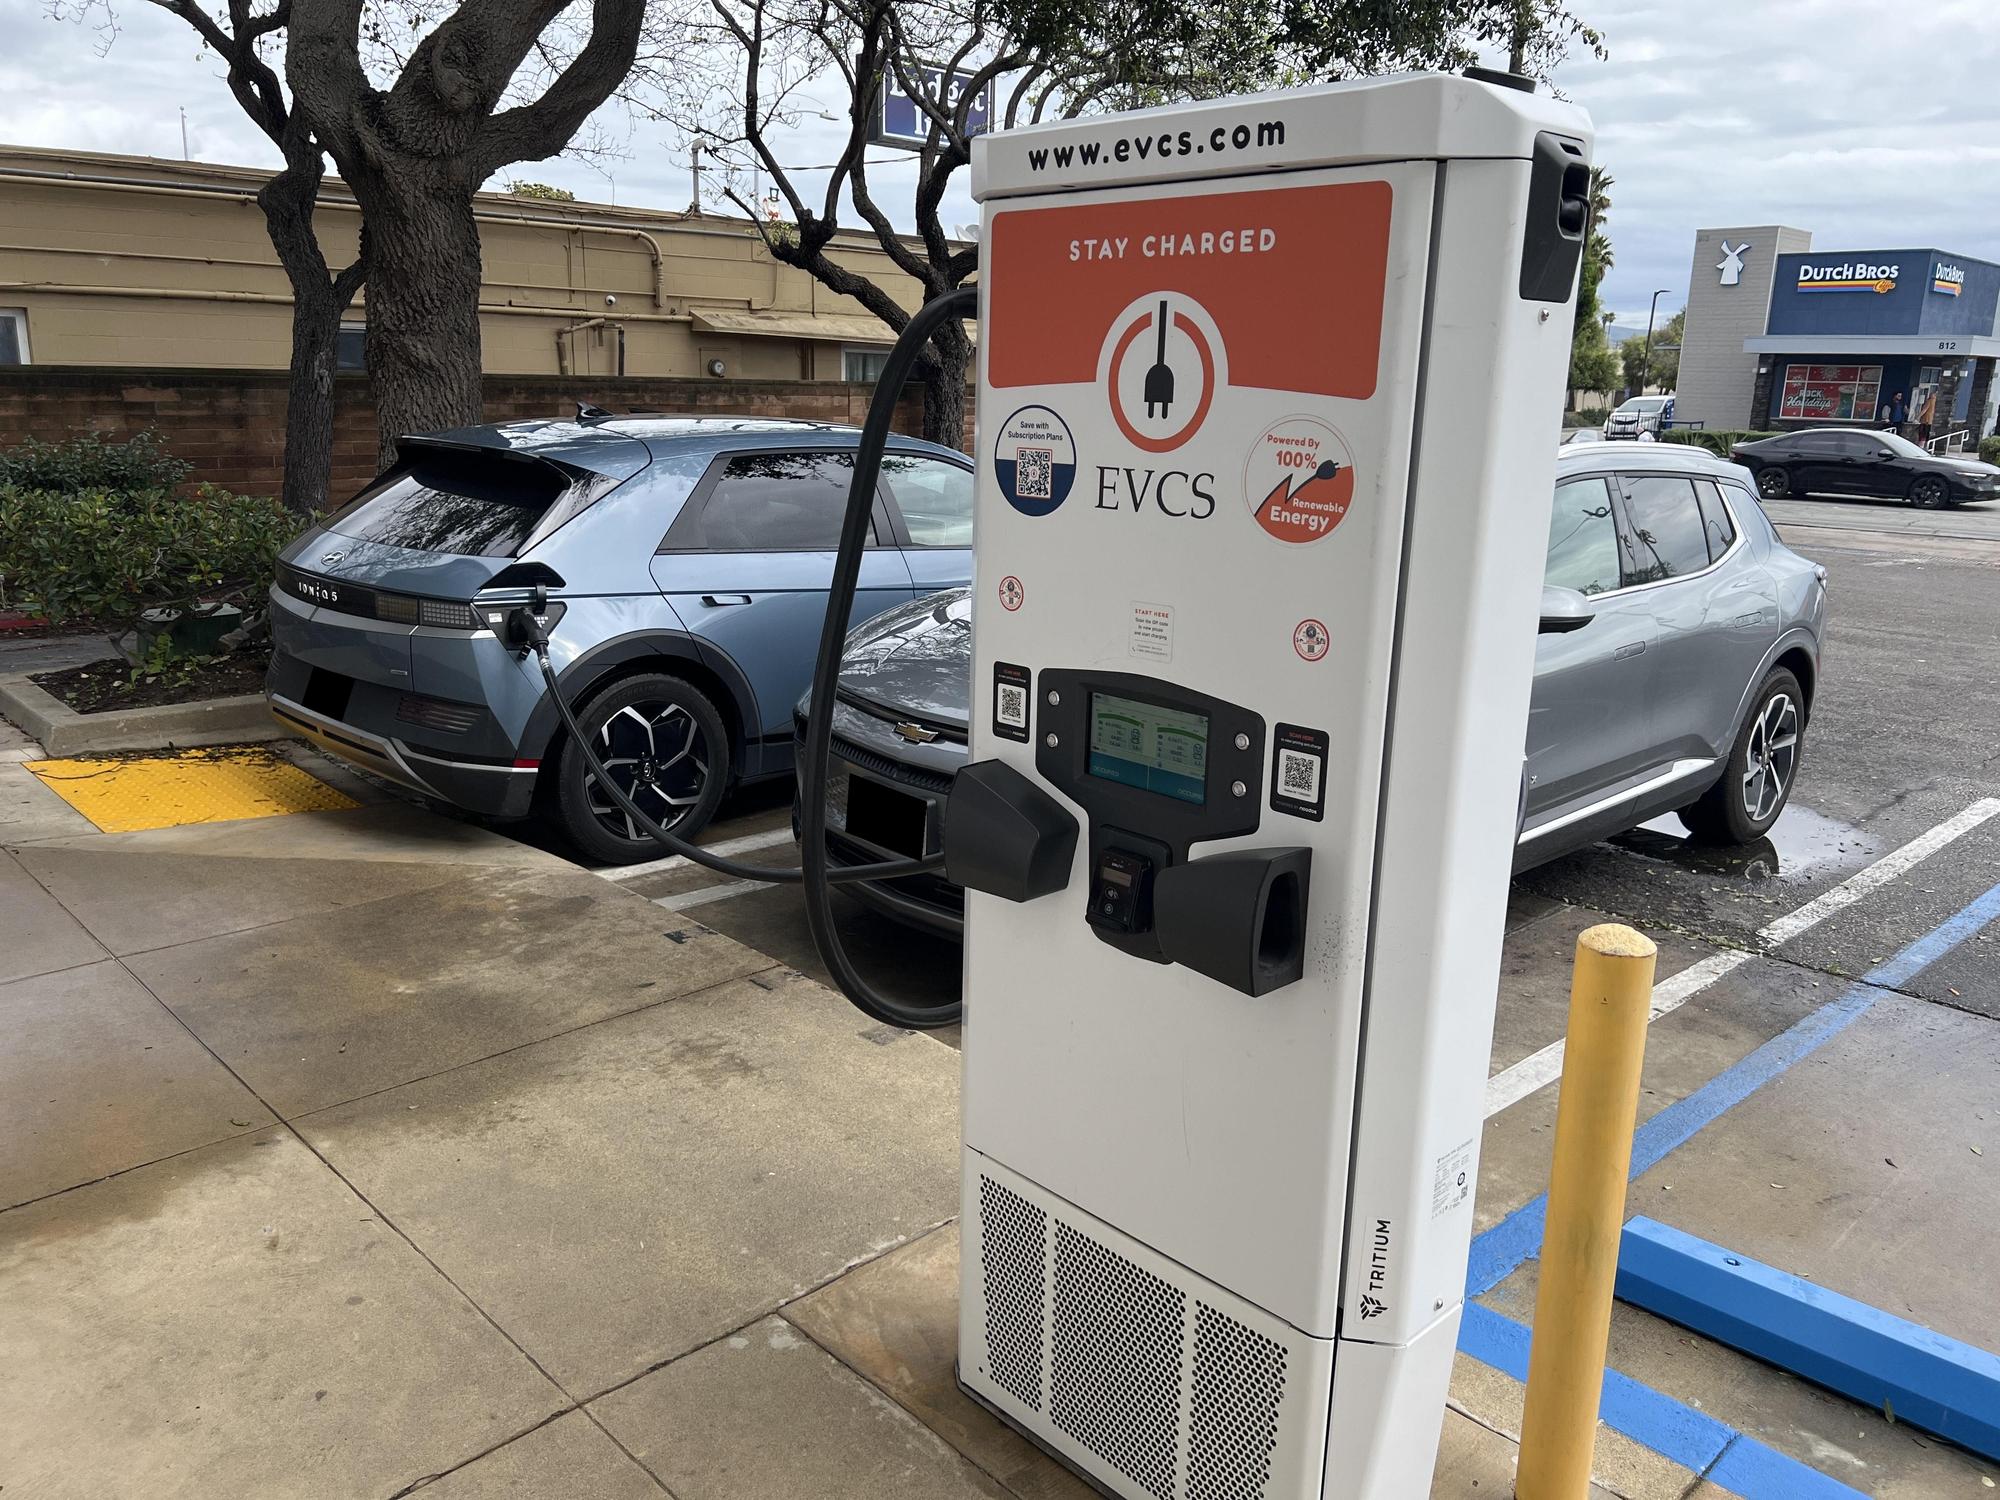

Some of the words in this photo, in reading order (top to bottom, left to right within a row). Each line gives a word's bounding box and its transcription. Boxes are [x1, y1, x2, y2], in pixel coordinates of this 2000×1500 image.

[889, 64, 985, 112] Bdgt
[1028, 120, 1285, 171] www.evcs.com
[1069, 237, 1128, 261] STAY
[1142, 228, 1276, 257] CHARGED
[1938, 342, 1956, 350] 812
[1020, 421, 1035, 429] Save
[1036, 421, 1049, 429] with
[1008, 431, 1045, 441] Subscription
[1046, 432, 1063, 441] Plans
[1267, 434, 1306, 447] Powered
[1308, 438, 1320, 449] By
[1276, 450, 1317, 469] 100%
[1094, 465, 1216, 519] EVCS
[1292, 498, 1344, 513] Renewable
[1270, 505, 1329, 532] Energy
[331, 591, 338, 601] 5
[1135, 608, 1152, 616] START
[1369, 1219, 1391, 1291] TRITIUM
